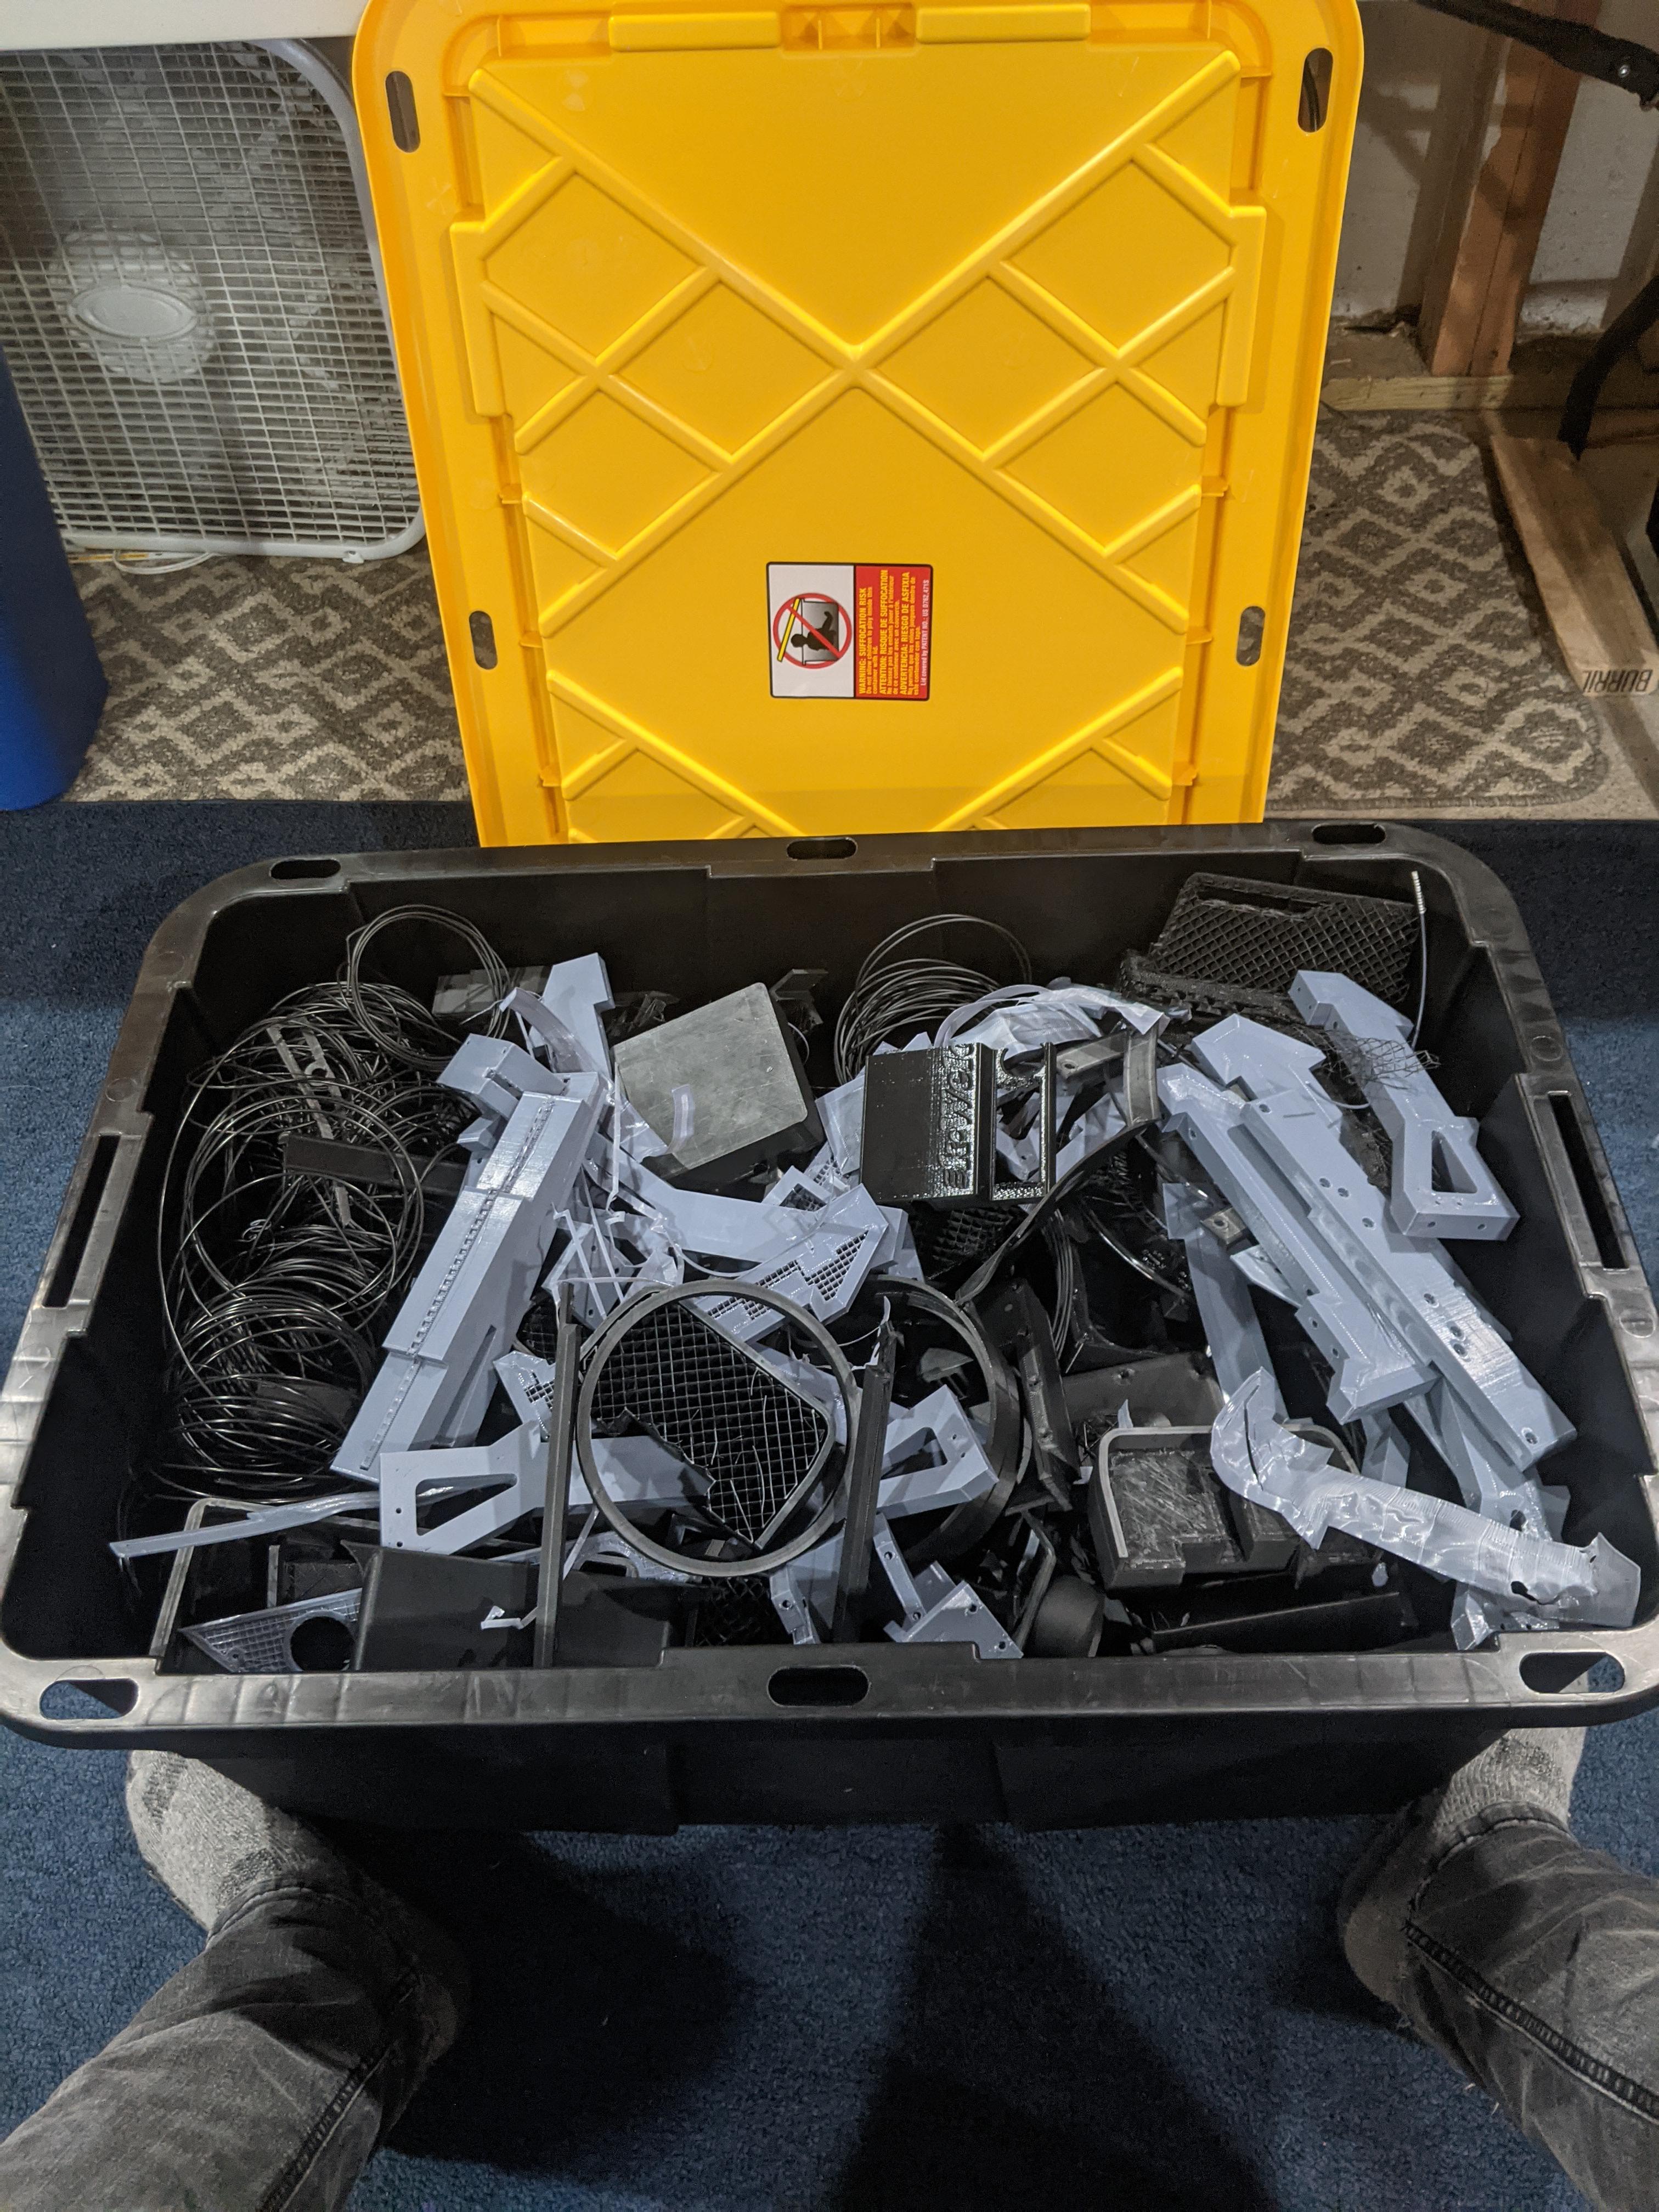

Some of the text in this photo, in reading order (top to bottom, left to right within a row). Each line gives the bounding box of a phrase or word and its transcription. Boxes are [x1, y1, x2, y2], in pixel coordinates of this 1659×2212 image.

[901, 572, 910, 601] ASFIXIA
[901, 603, 909, 613] DE
[880, 618, 887, 628] DE
[900, 644, 908, 695] ADVERTENCIA:
